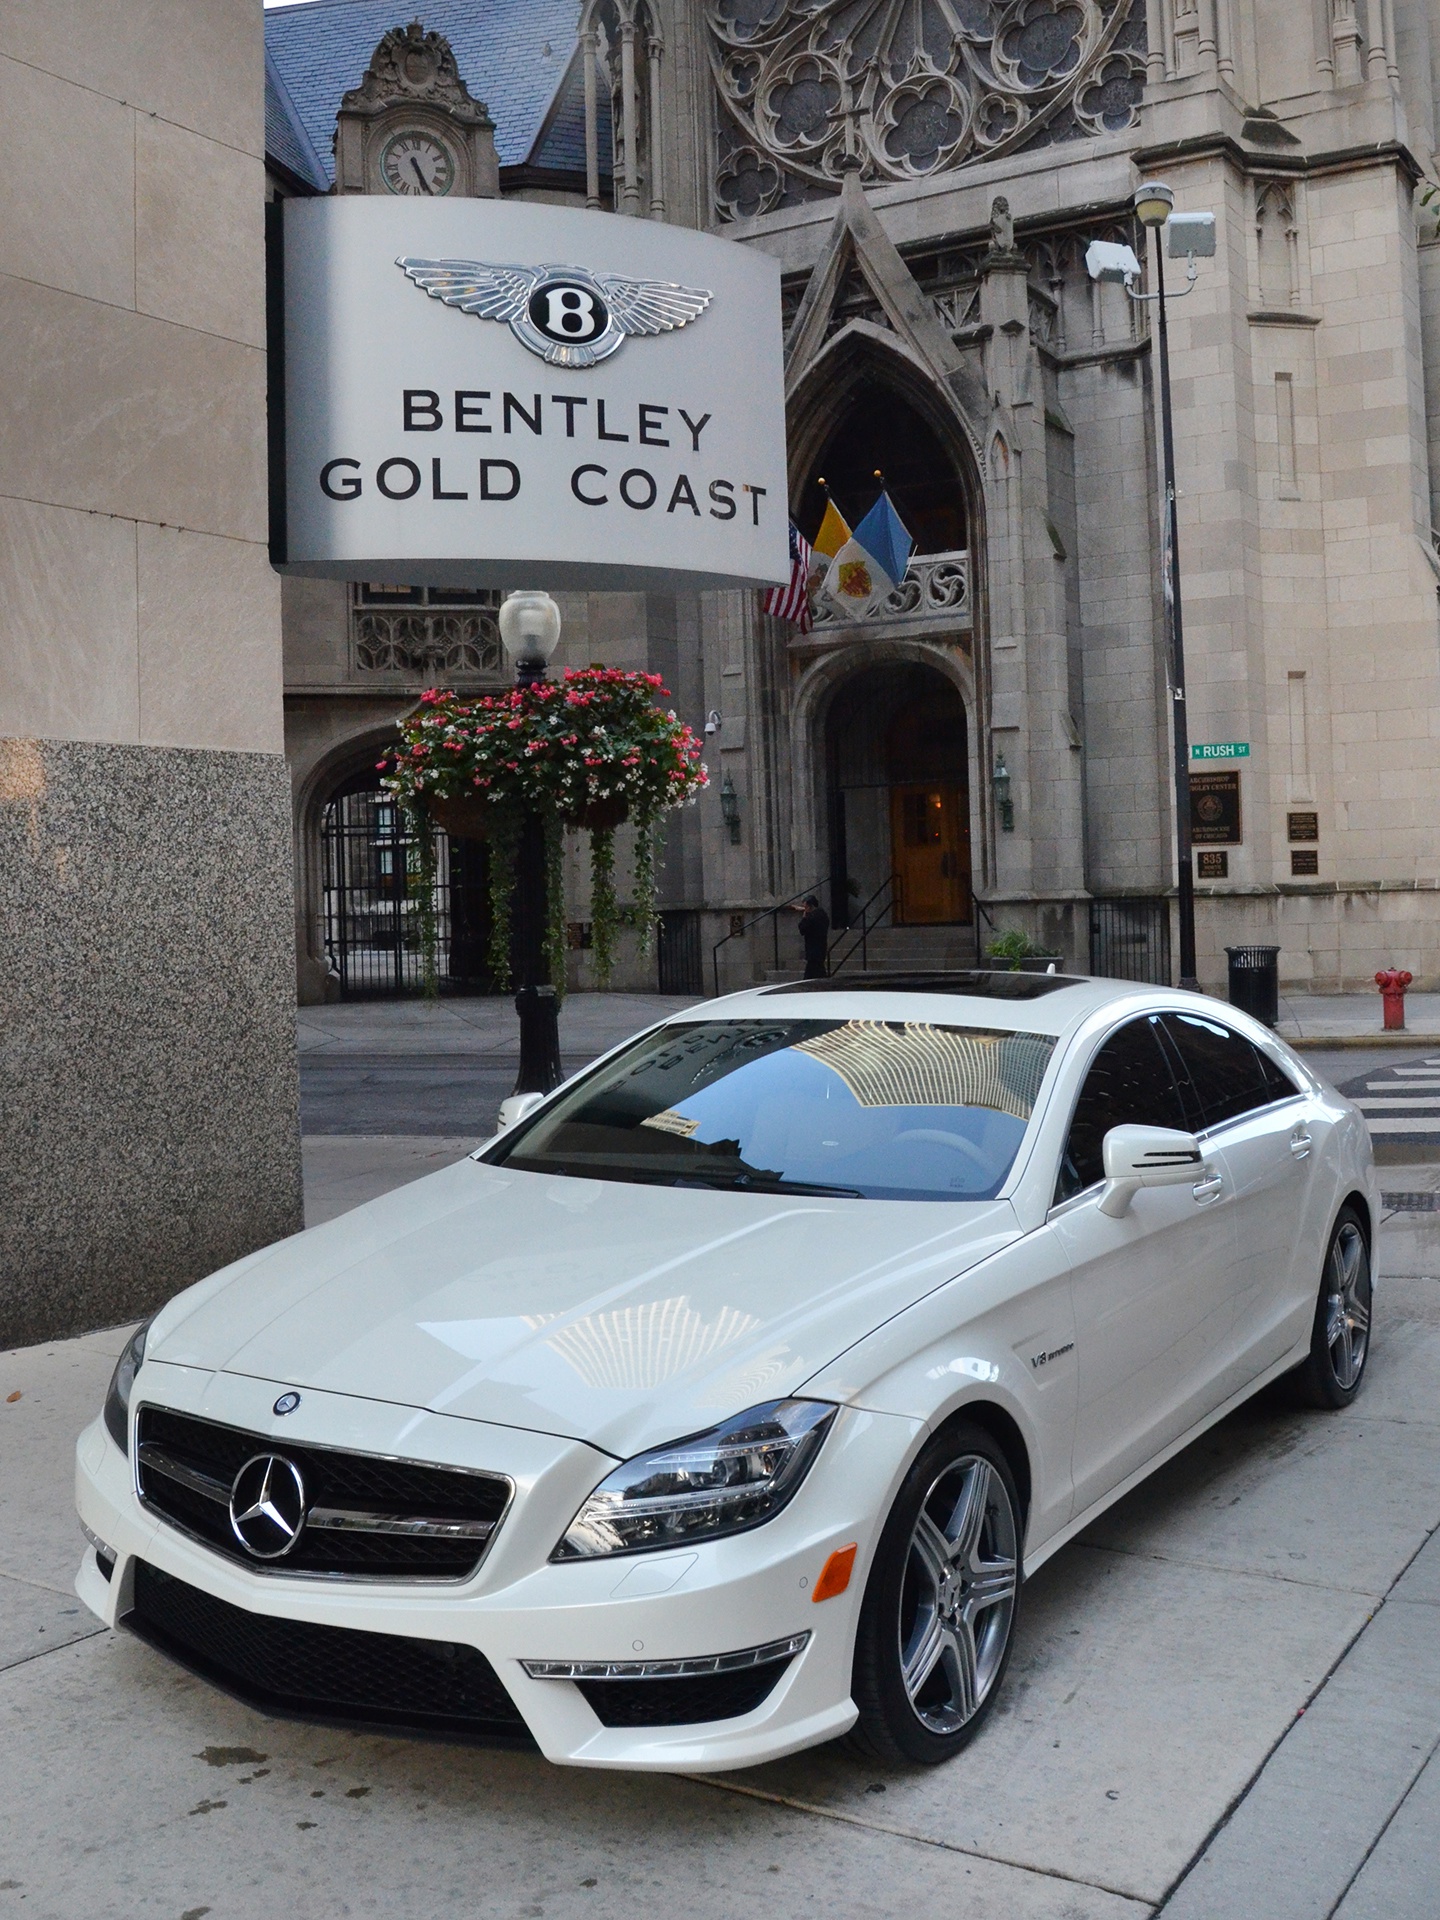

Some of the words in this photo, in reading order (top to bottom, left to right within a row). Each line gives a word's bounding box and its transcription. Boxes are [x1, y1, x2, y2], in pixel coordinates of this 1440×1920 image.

[545, 287, 596, 338] B
[402, 389, 712, 452] BENTLEY
[319, 457, 522, 502] GOLD
[570, 463, 767, 526] COAST
[1203, 745, 1235, 757] RUSH
[1238, 746, 1246, 754] ST
[1211, 783, 1237, 791] CENTER
[1203, 853, 1222, 865] 835
[1031, 1351, 1047, 1368] V8
